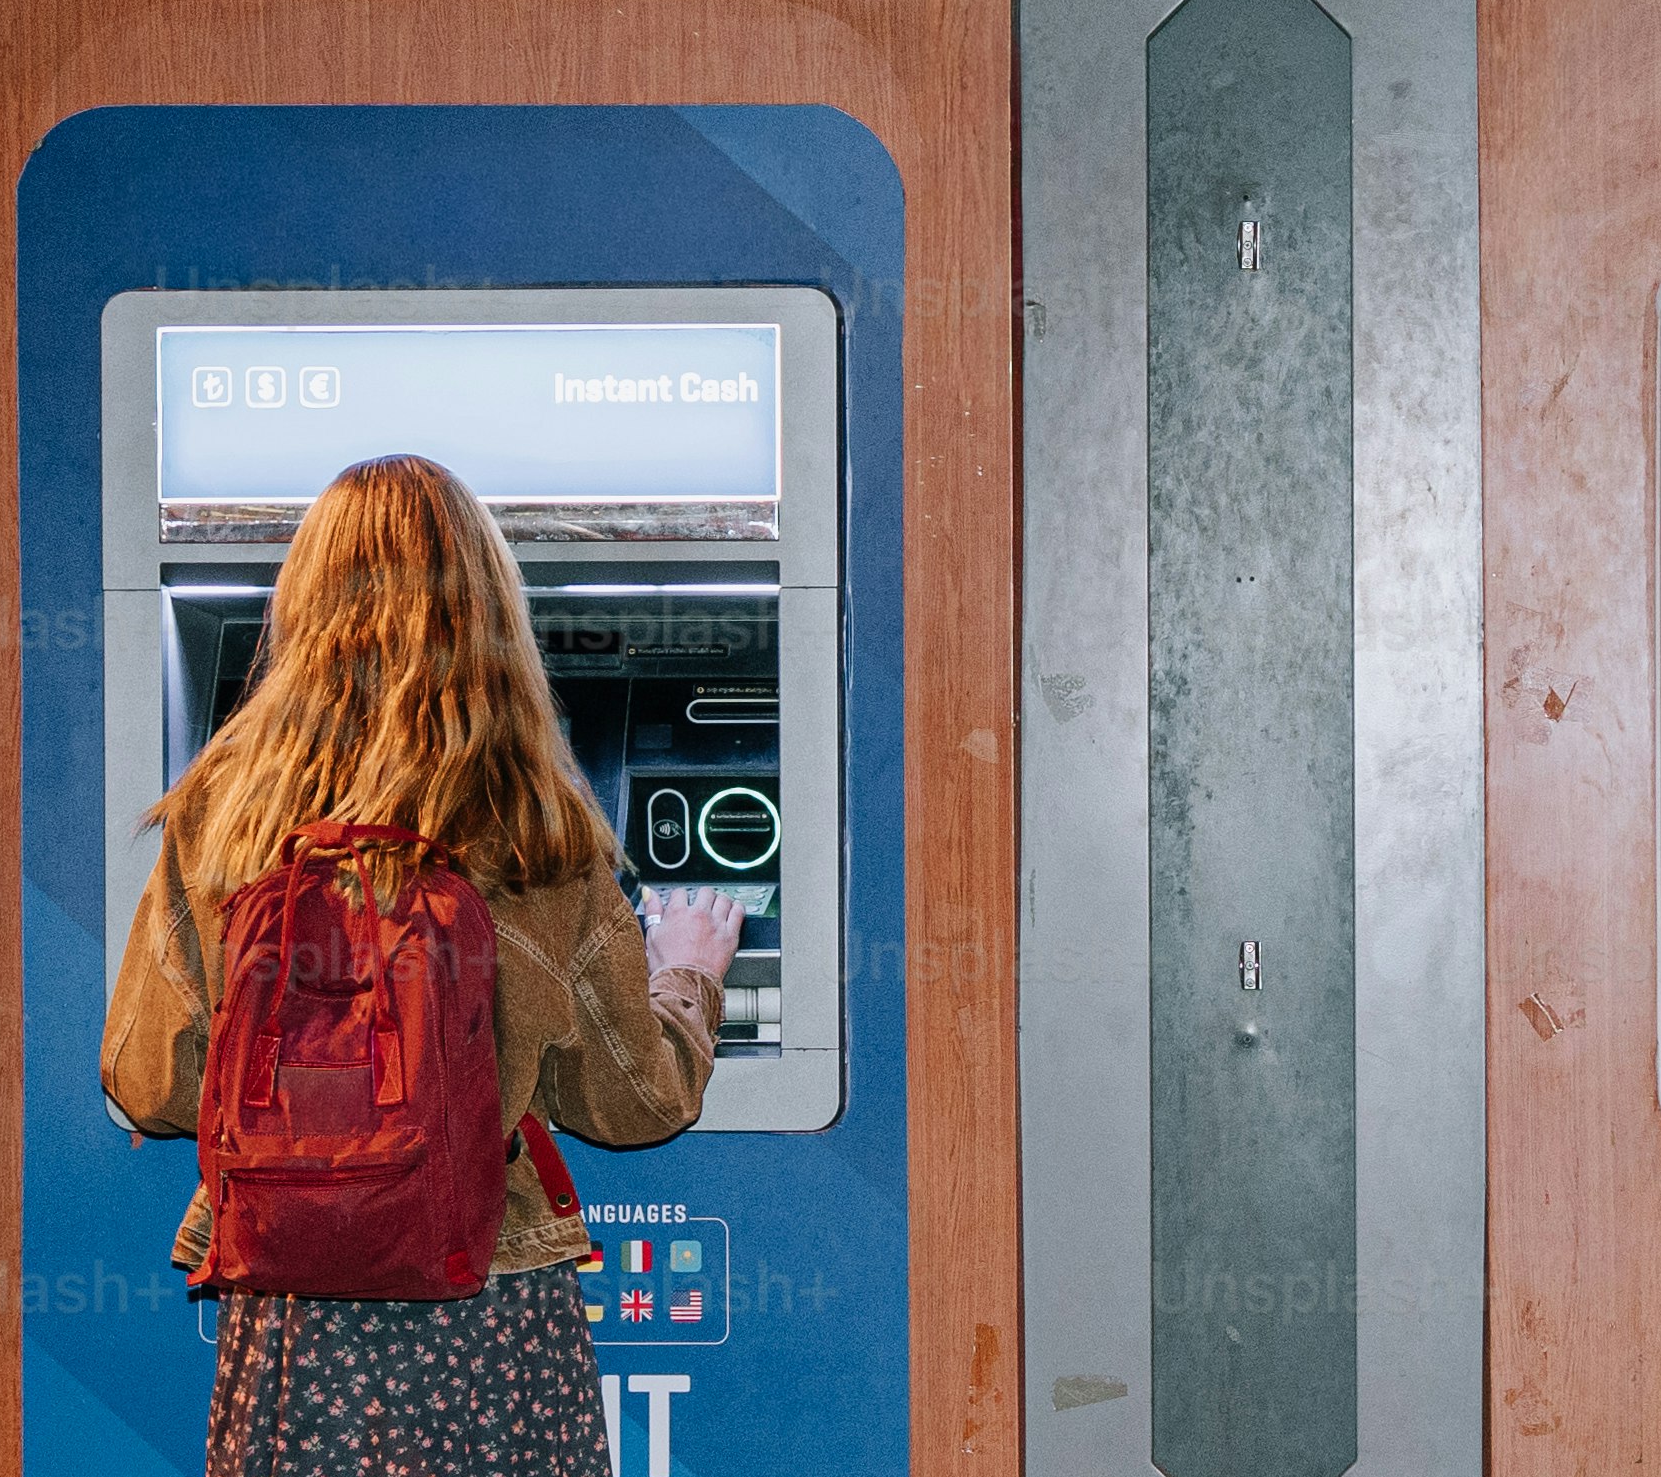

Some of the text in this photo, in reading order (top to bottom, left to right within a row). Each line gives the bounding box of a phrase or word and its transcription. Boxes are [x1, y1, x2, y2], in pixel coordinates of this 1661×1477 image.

[255, 370, 276, 402] $
[308, 372, 330, 400] €
[554, 371, 759, 404] Instant Cash
